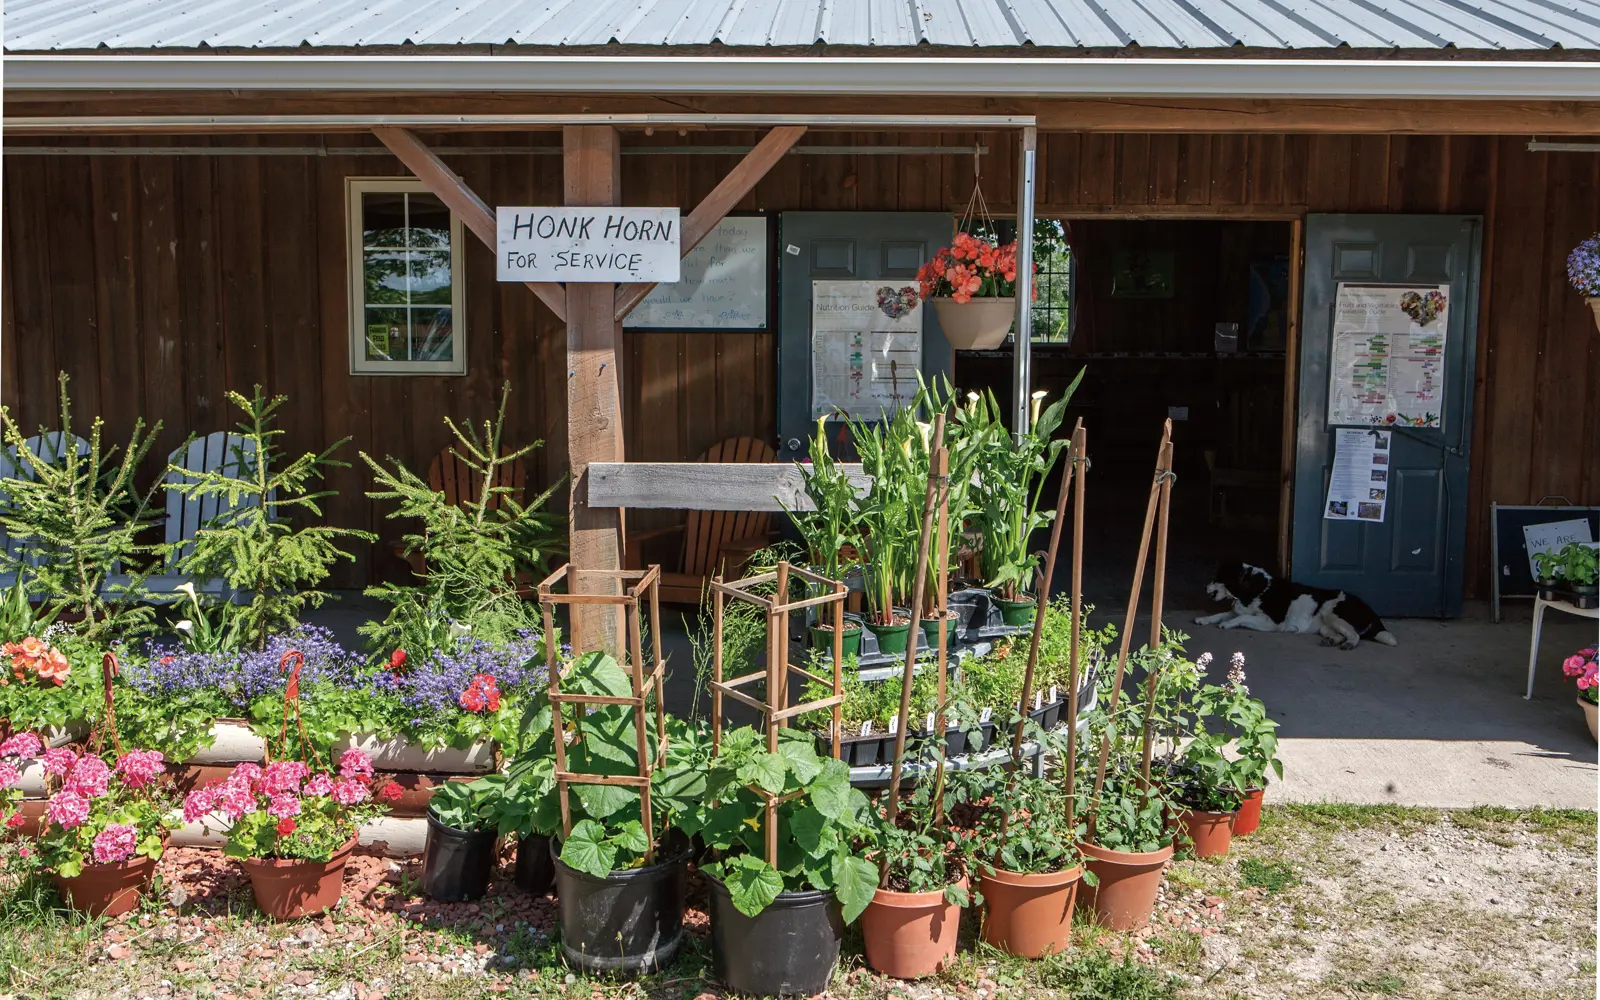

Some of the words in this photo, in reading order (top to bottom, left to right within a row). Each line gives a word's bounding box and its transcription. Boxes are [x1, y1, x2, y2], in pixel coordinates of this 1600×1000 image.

[513, 213, 595, 240] HONK
[603, 215, 673, 241] HORN
[714, 225, 748, 241] today
[715, 241, 737, 253] than
[507, 251, 538, 269] FOR
[554, 250, 643, 271] SERVICE
[710, 256, 727, 268] for
[684, 275, 704, 285] how
[642, 295, 672, 305] would
[816, 303, 850, 312] Nutrition
[851, 303, 875, 312] Guide
[1530, 537, 1550, 548] WE
[1556, 534, 1577, 545] ARE
